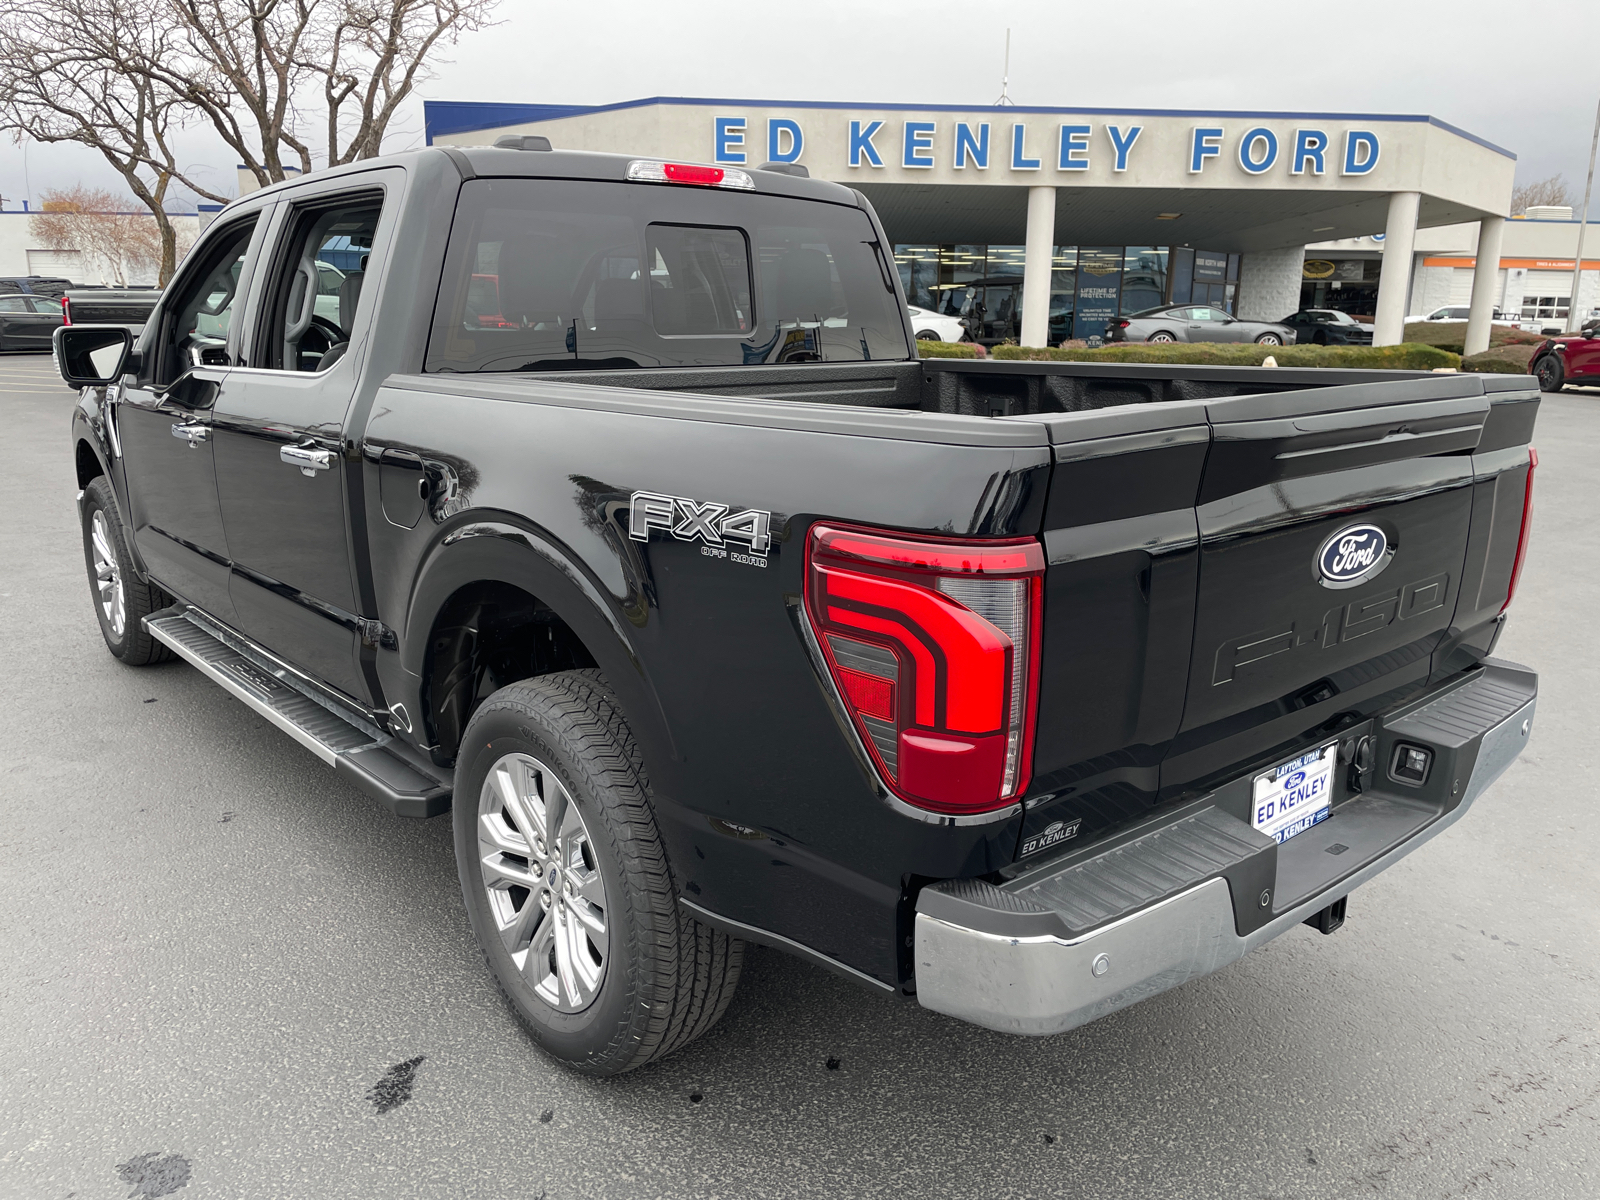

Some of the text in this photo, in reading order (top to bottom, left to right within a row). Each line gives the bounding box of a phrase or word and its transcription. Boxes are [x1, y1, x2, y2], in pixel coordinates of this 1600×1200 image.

[714, 116, 1381, 176] ED KENLEY FORD
[629, 490, 771, 557] FX4
[701, 546, 768, 568] OFF ROAD
[1332, 533, 1377, 573] Ford
[1212, 571, 1450, 686] F-150
[1303, 749, 1320, 765] UTAH
[1258, 801, 1275, 824] ED
[1279, 774, 1327, 813] KENLEY
[1022, 824, 1080, 853] ED KENLEY
[1283, 814, 1315, 840] KENLEY
